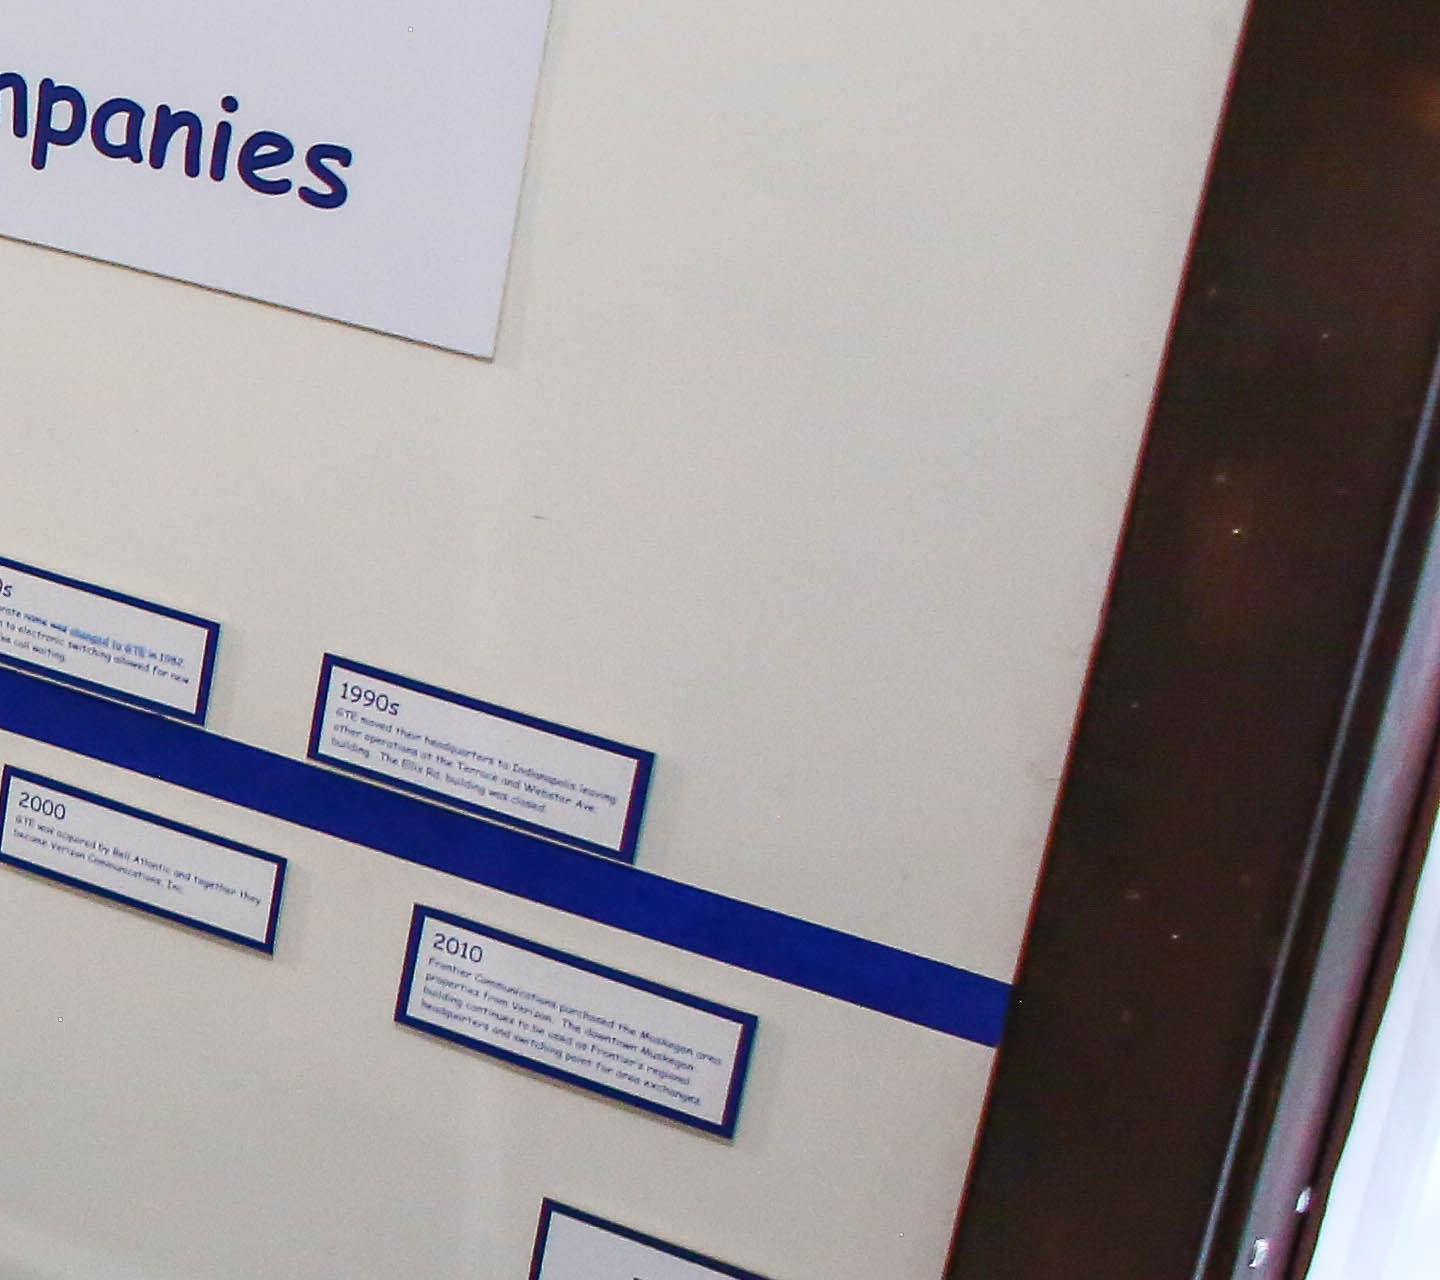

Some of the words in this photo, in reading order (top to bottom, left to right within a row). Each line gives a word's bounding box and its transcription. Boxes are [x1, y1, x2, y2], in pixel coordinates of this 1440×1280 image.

[338, 681, 401, 717] 1990s
[17, 789, 66, 822] 2000
[431, 931, 484, 965] 2010
